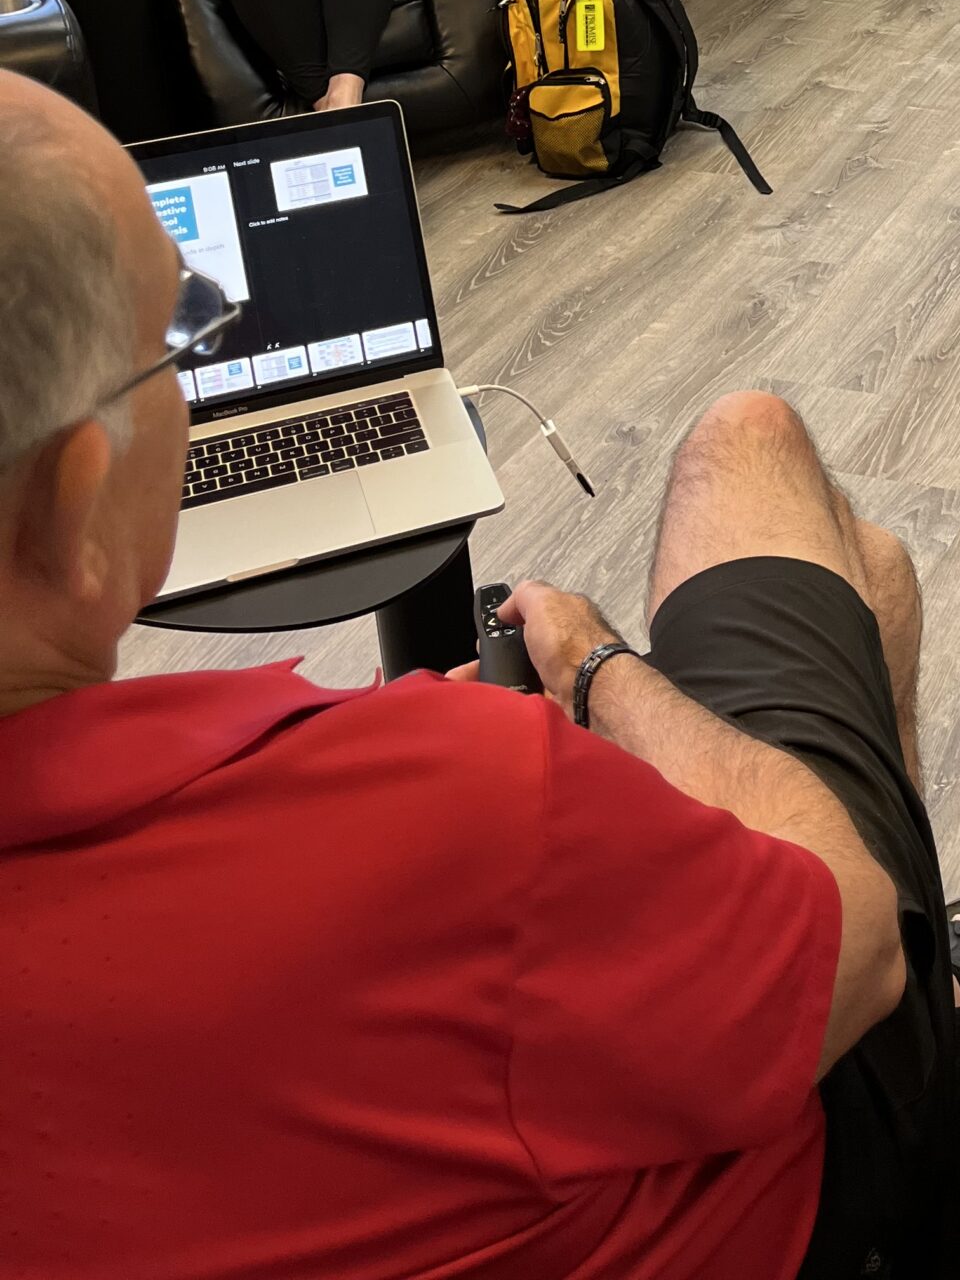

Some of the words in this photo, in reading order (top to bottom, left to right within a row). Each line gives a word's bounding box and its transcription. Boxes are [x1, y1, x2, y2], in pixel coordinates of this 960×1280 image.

[156, 206, 187, 217] estive
[161, 217, 178, 227] ool
[212, 409, 238, 418] MacBook
